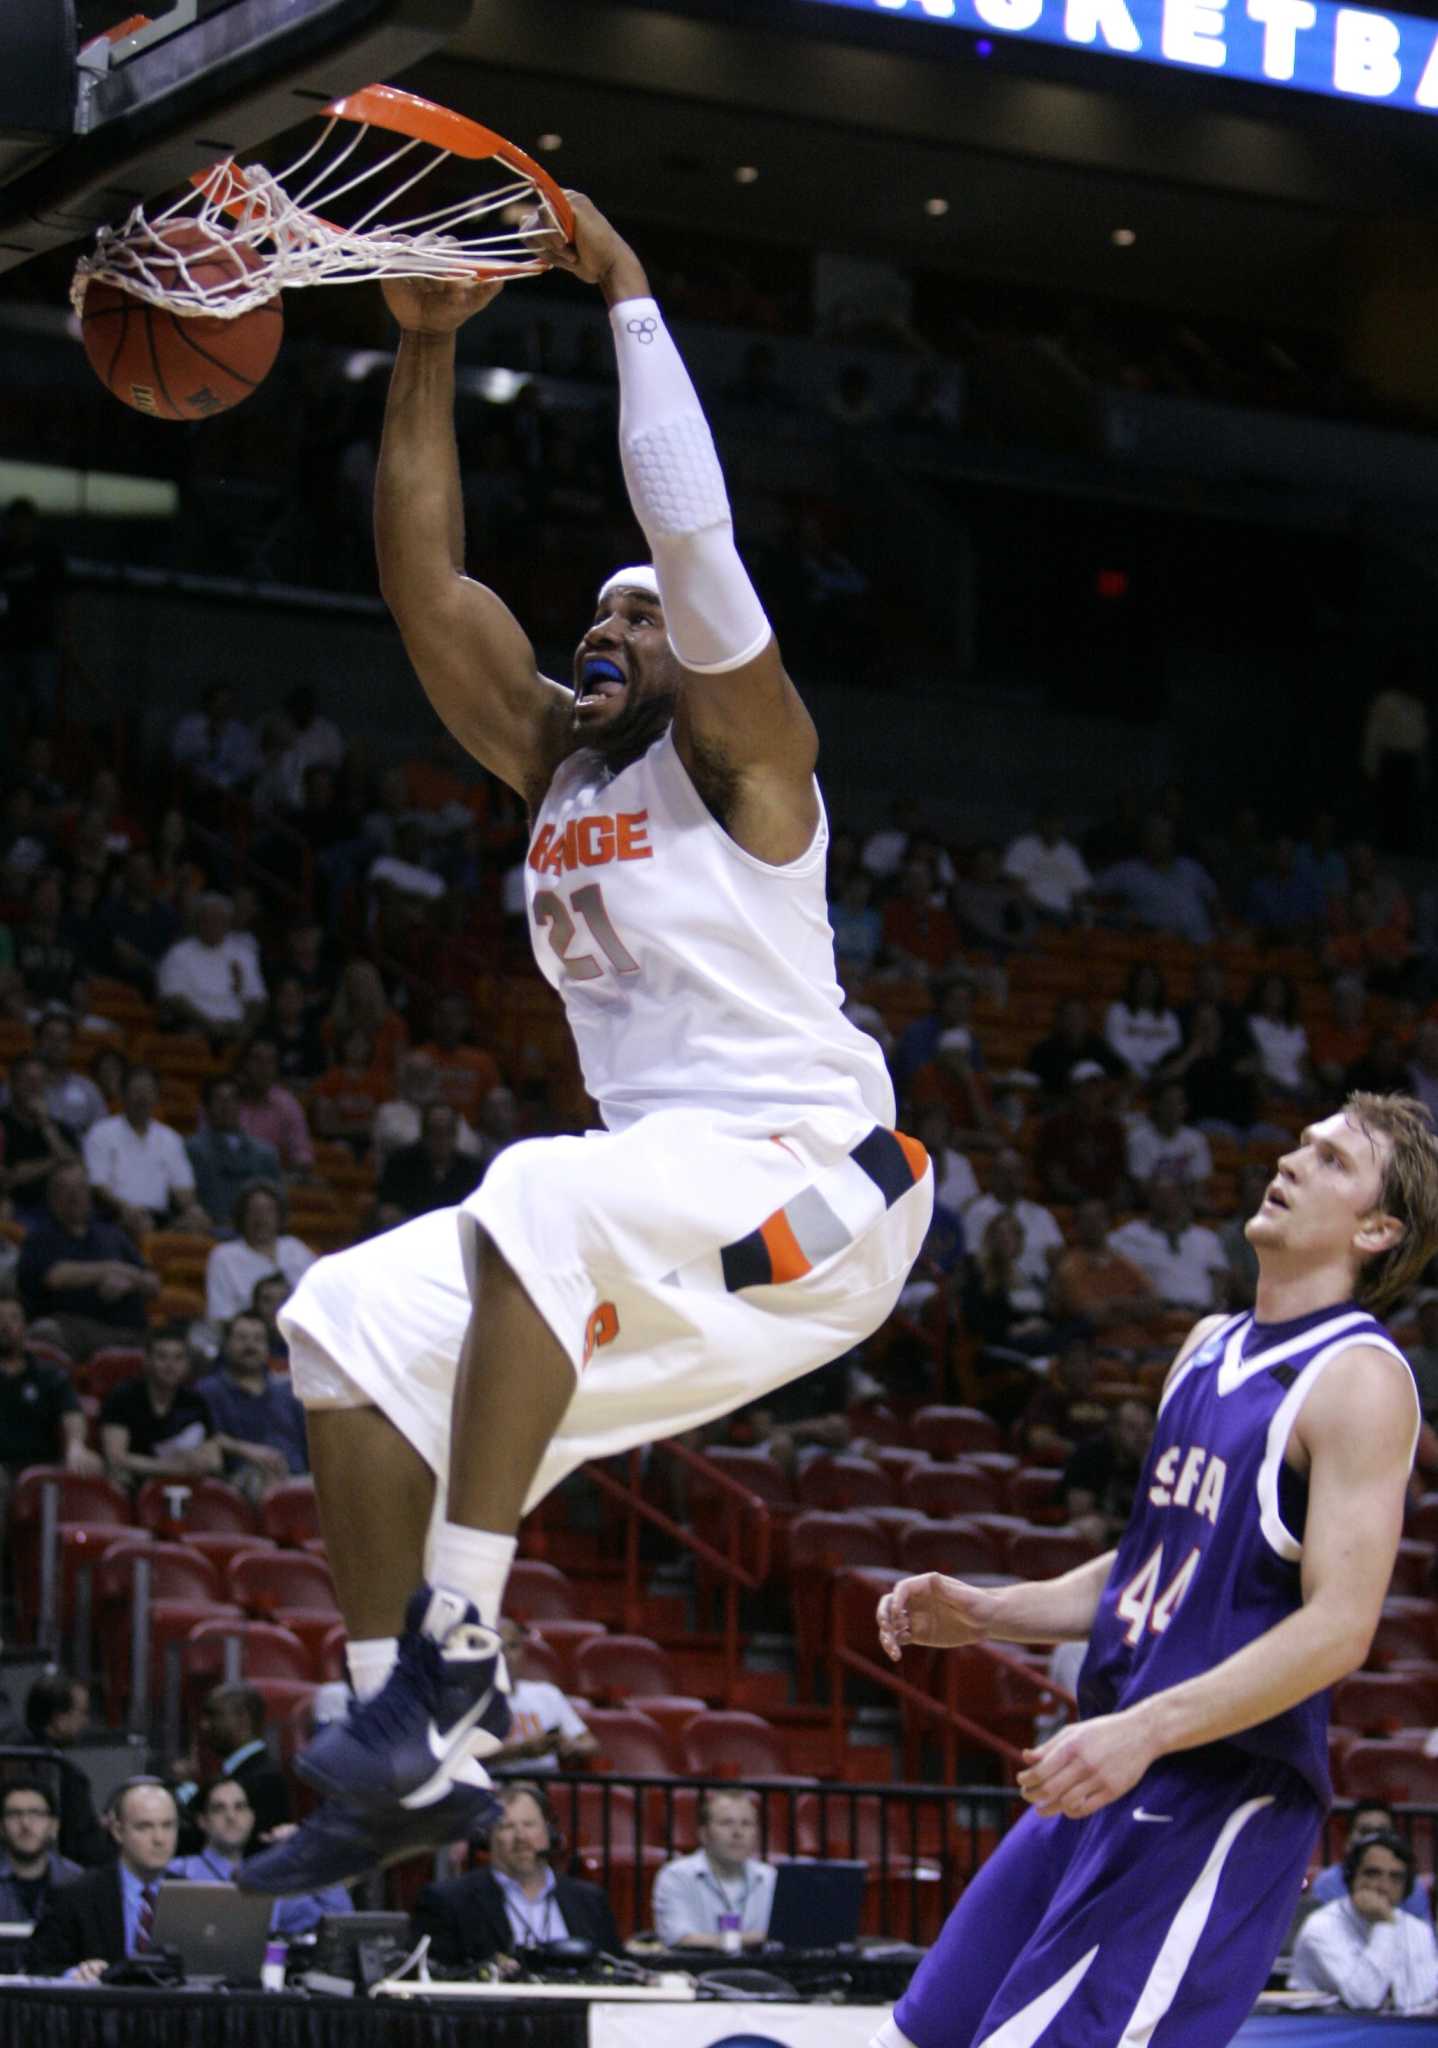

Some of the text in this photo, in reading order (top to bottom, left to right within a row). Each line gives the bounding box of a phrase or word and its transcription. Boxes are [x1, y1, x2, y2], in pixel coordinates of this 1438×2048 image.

[533, 883, 641, 981] 21
[1149, 1446, 1227, 1526] SFA
[1117, 1542, 1200, 1648] 44
